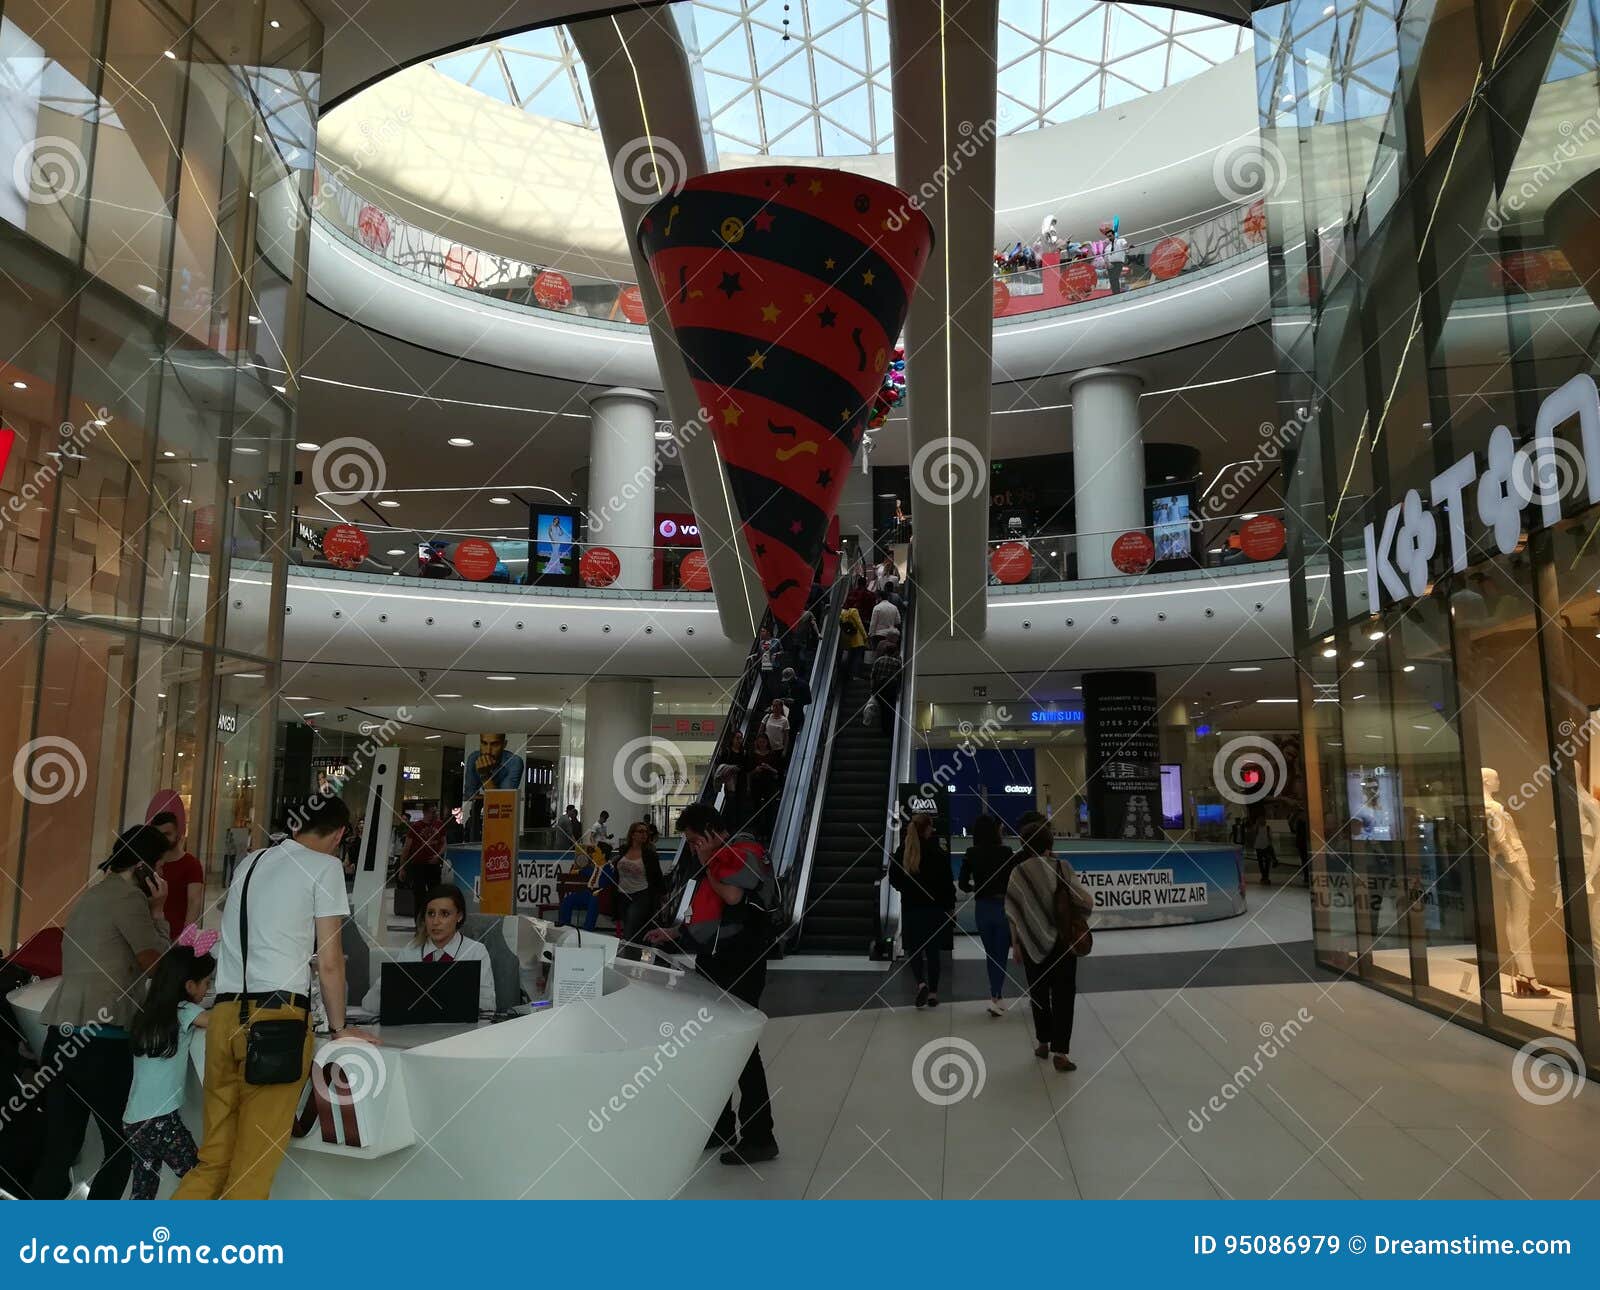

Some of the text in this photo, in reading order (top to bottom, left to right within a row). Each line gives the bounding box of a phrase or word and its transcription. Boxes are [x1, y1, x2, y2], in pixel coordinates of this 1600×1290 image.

[1032, 711, 1084, 721] SAMSUN
[1004, 785, 1033, 795] Galaxy
[1077, 870, 1113, 886] ÂTEA
[1094, 886, 1206, 907] SINGUR WIZZ AIR
